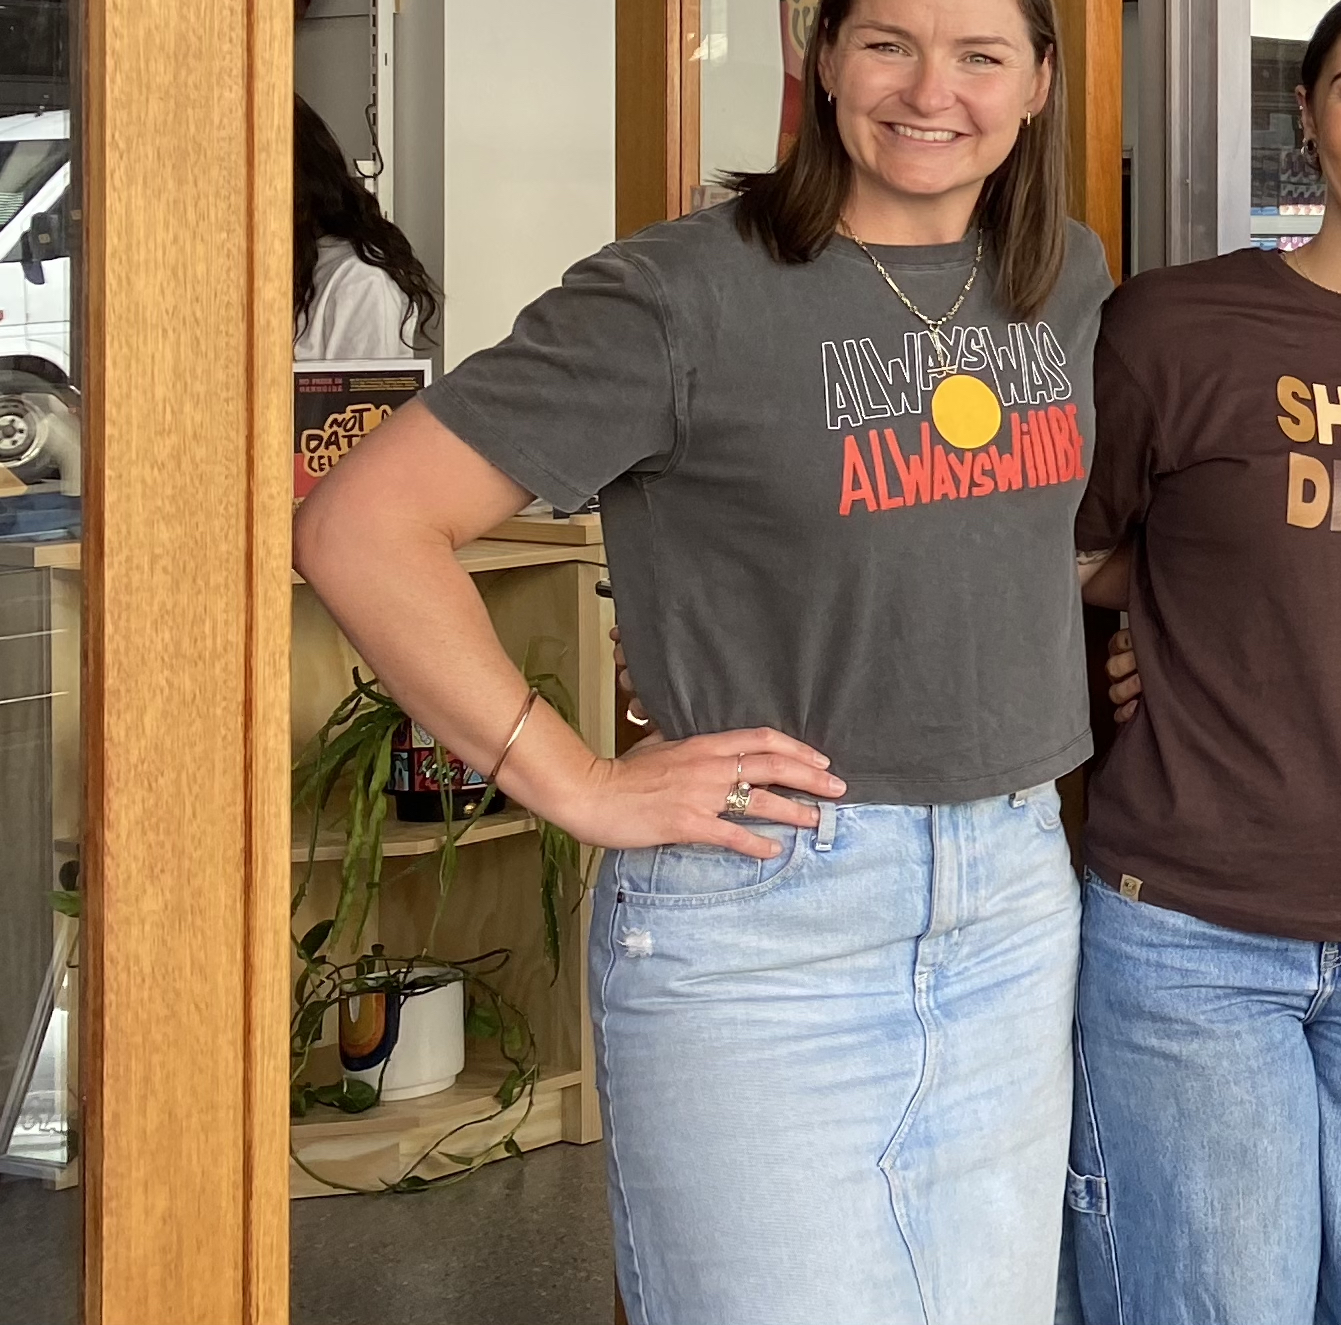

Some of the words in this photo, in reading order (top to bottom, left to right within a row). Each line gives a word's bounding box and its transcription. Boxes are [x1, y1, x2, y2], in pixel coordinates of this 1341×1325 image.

[822, 327, 987, 430] ALWAYS
[979, 321, 1072, 407] WAS
[305, 430, 366, 454] DAT
[327, 407, 372, 433] NOT
[839, 421, 996, 516] ALWAYS
